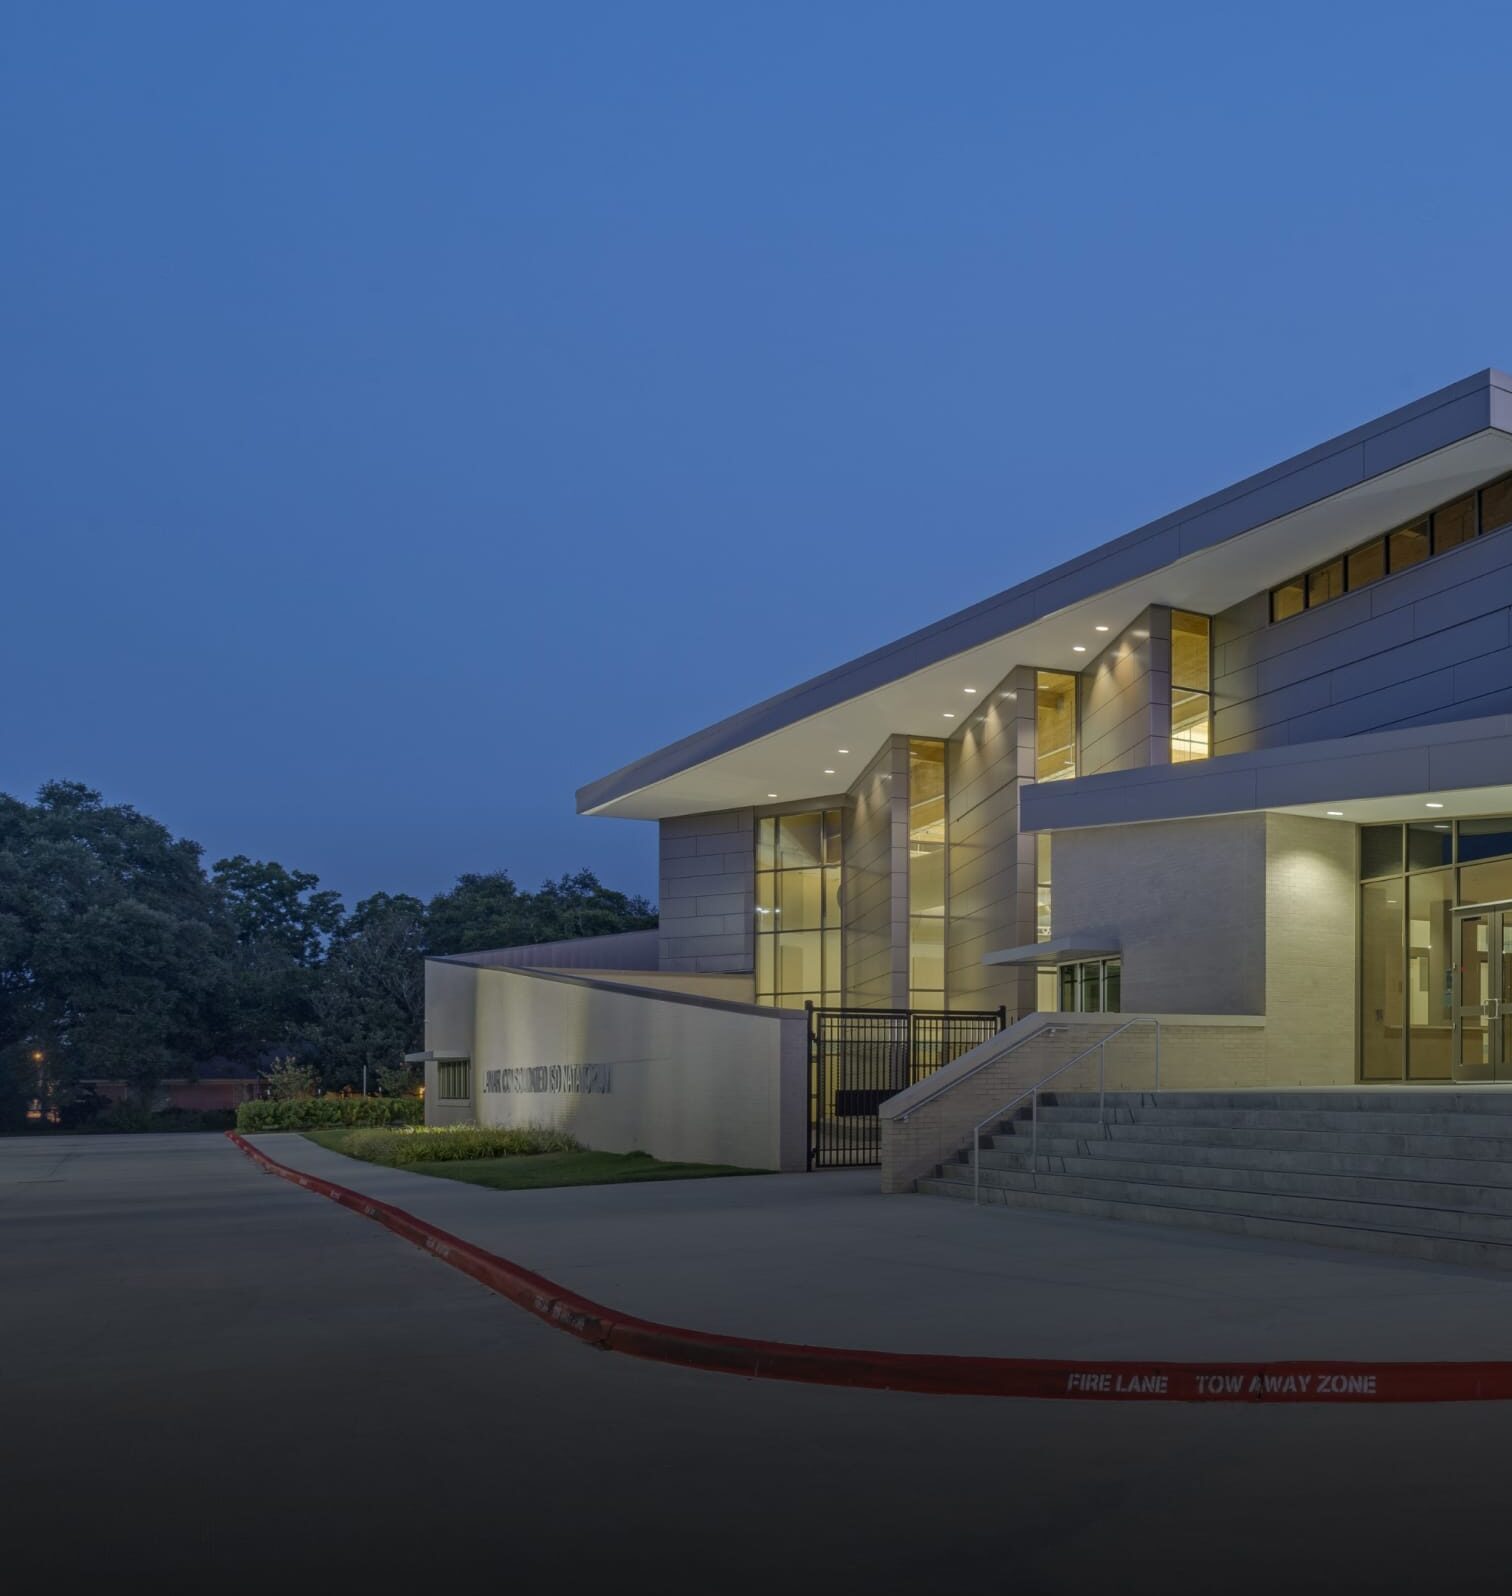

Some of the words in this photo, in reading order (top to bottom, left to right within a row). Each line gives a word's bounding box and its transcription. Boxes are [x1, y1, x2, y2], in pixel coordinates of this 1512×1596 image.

[1067, 1373, 1112, 1392] FIRE
[1115, 1374, 1169, 1393] LANE
[1196, 1374, 1245, 1394] TOW
[1248, 1374, 1312, 1394] AWAY
[1316, 1374, 1377, 1394] ZONE
